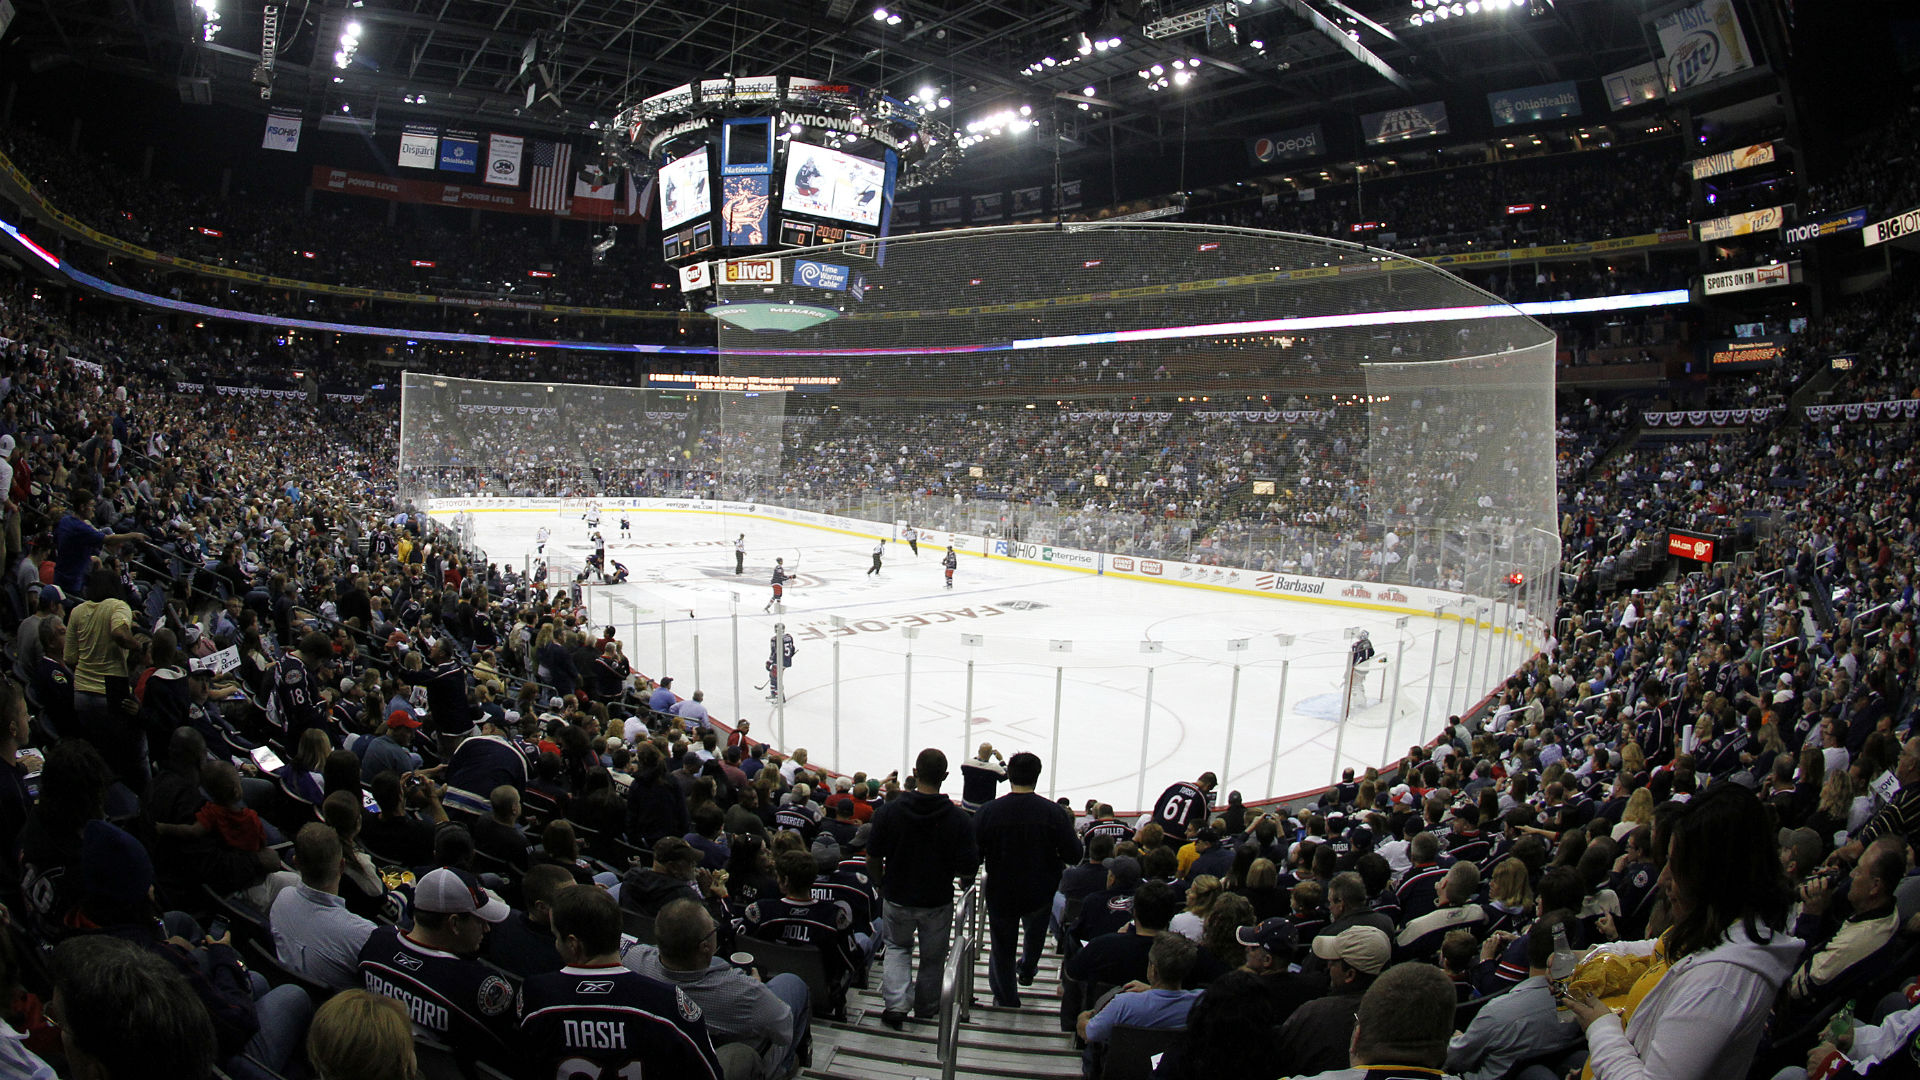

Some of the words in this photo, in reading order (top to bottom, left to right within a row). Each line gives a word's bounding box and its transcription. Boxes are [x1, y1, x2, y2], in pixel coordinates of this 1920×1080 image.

[703, 81, 775, 96] tickemaster
[1515, 93, 1575, 112] OhioHealth
[671, 117, 709, 137] ARENA
[870, 129, 899, 147] AREN
[1276, 133, 1316, 155] pepsi
[402, 143, 435, 157] Dispatch
[724, 165, 769, 175] Nationwide
[797, 233, 805, 245] 0
[816, 225, 844, 239] 20:00
[1786, 222, 1820, 243] more
[728, 261, 772, 280] alive!
[820, 264, 838, 274] Time
[820, 272, 845, 283] Warner
[818, 279, 839, 288] Cable
[1707, 275, 1734, 290] SPORTS
[1734, 273, 1745, 286] ON
[1745, 271, 1755, 284] FM
[439, 296, 465, 304] Central
[1713, 351, 1733, 364] FAN
[1733, 347, 1777, 362] LOUNGE
[446, 499, 471, 507] TOYOTA
[376, 540, 386, 553] 19
[1670, 539, 1692, 551] AAA.com
[1114, 557, 1133, 565] GIANT
[1275, 576, 1325, 595] Barbasol
[798, 604, 1005, 641] FACE-OFF
[290, 688, 305, 706] 18
[1163, 794, 1193, 826] 61
[782, 925, 811, 943] BOLL
[364, 970, 449, 1033] BRASSARD
[563, 1019, 628, 1050] NASH
